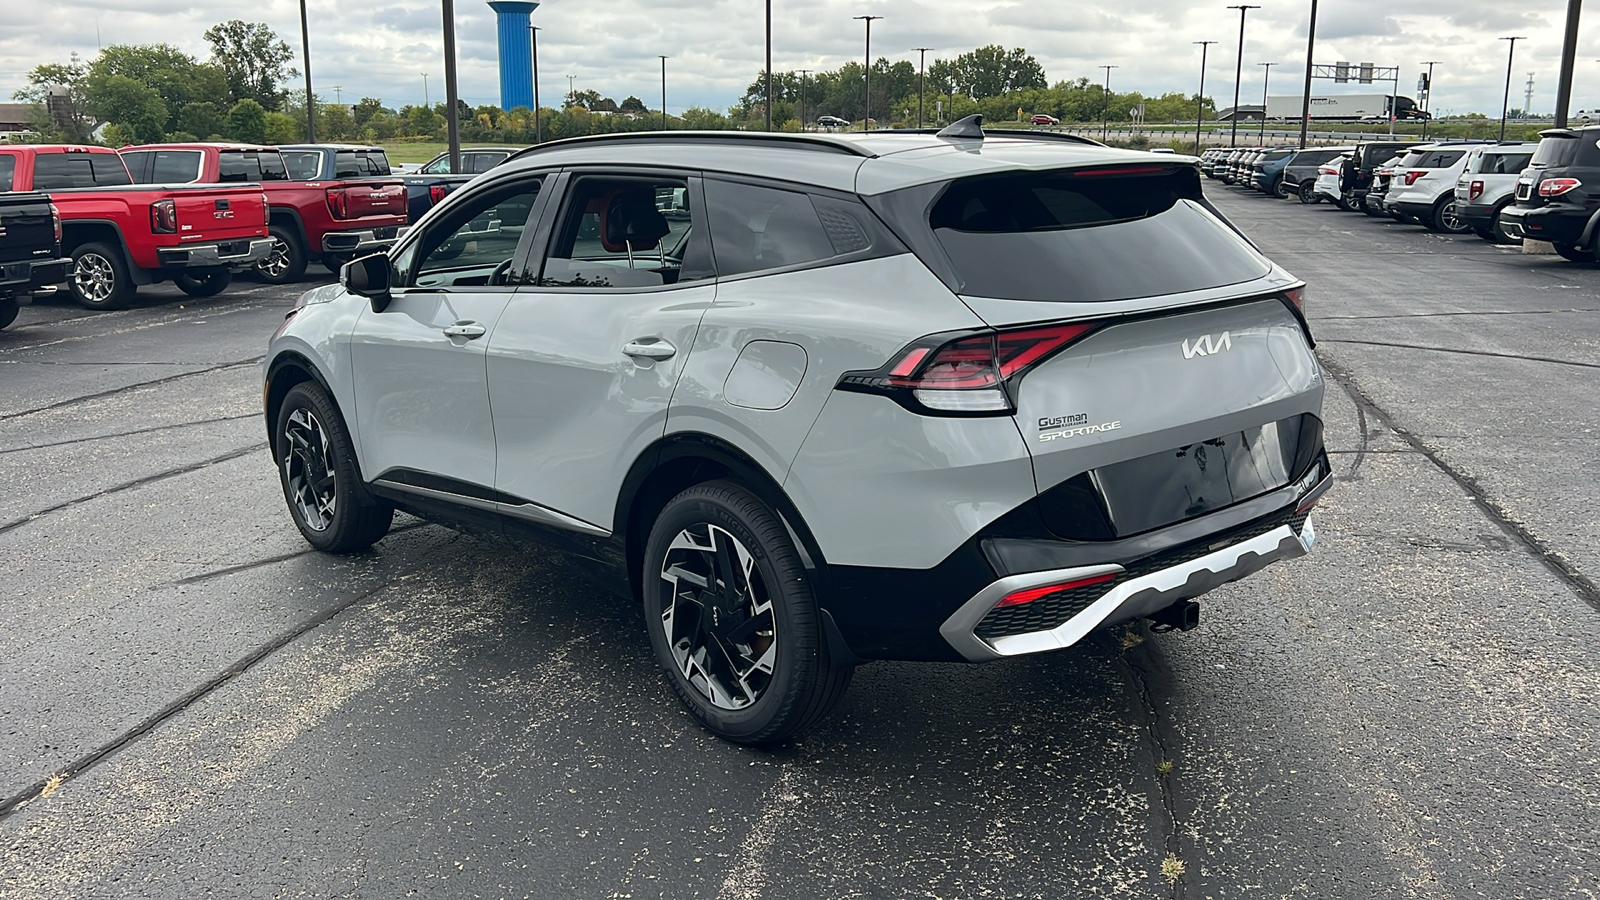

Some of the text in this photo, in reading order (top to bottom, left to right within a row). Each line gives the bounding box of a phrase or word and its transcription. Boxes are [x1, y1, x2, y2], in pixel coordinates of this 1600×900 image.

[1181, 330, 1232, 360] KIA
[1038, 420, 1122, 443] SPORTAGE
[719, 511, 764, 560] MICHELIN
